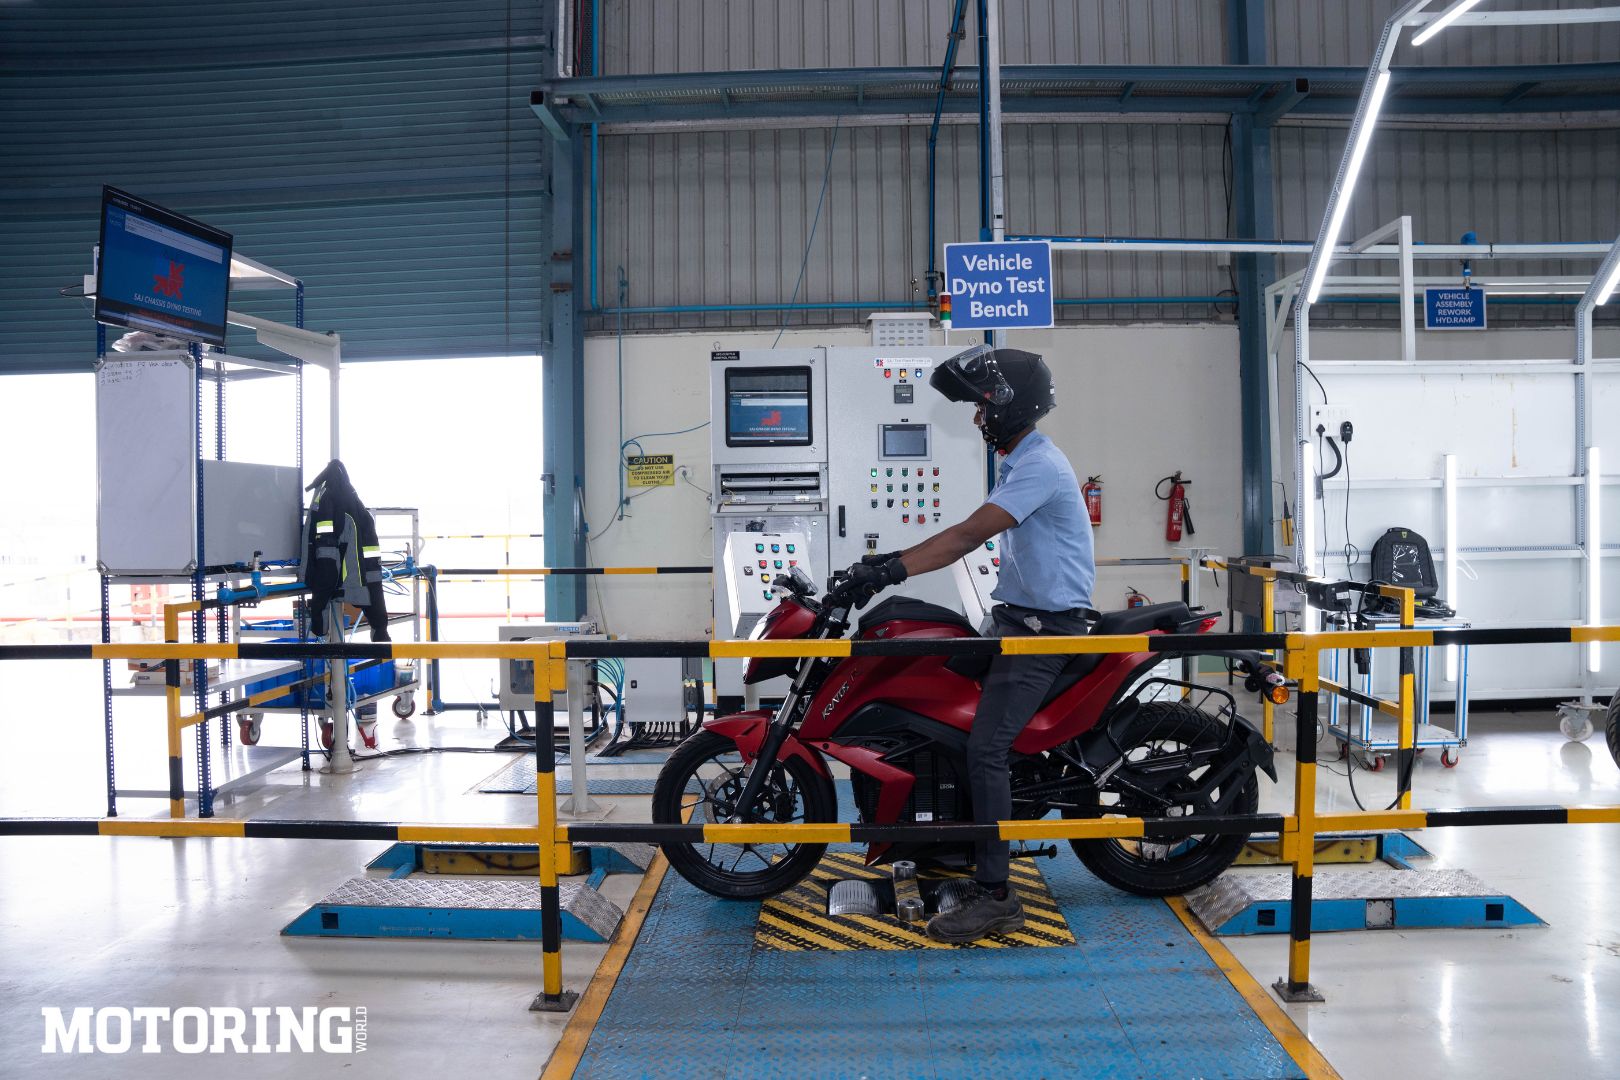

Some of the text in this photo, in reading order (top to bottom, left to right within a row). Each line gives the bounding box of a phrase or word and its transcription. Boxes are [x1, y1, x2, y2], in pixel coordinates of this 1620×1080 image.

[962, 253, 1033, 272] Vehicle
[952, 276, 1046, 298] Dyno Test
[134, 293, 144, 302] SAJ
[144, 296, 166, 308] CHASSIS
[182, 305, 202, 317] TESTING
[970, 300, 1029, 318] Bench
[633, 456, 668, 464] CAUTION
